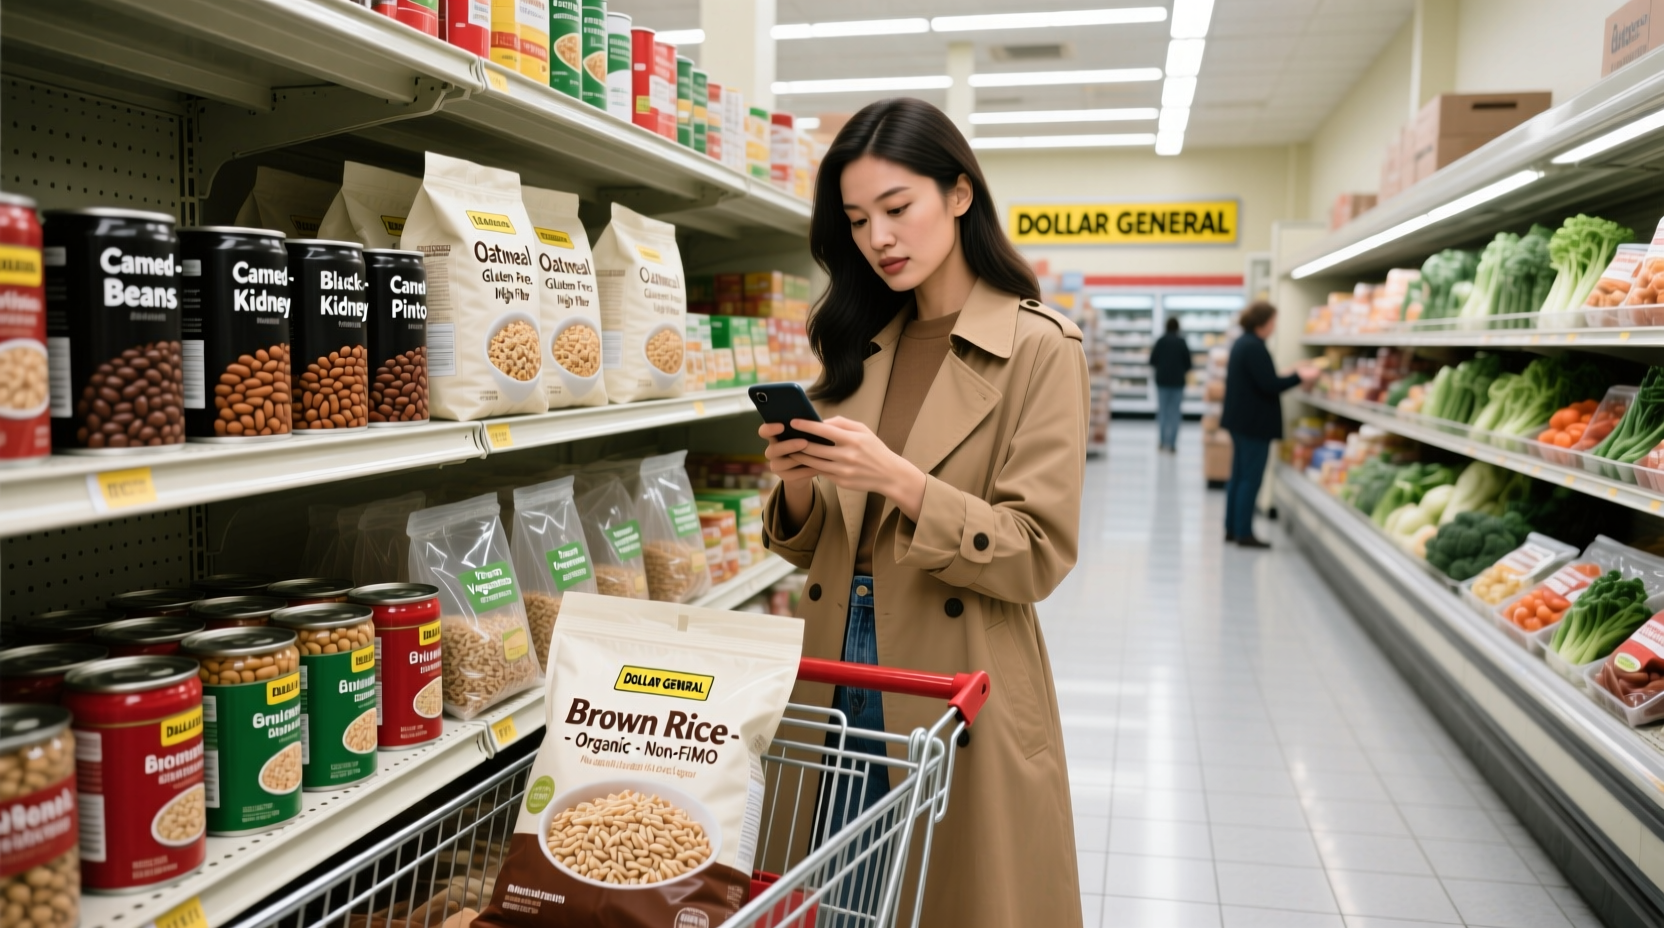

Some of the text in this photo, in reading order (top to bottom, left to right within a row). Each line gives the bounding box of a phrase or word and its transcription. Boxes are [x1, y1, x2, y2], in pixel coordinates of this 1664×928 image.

[1017, 211, 1230, 235] DOLLAR GENERAL
[103, 277, 178, 309] Beans
[234, 289, 291, 318] Kidney
[321, 295, 369, 322] Kidney
[392, 299, 427, 320] Pinto
[565, 697, 658, 736] Brown
[575, 732, 631, 754] Organic
